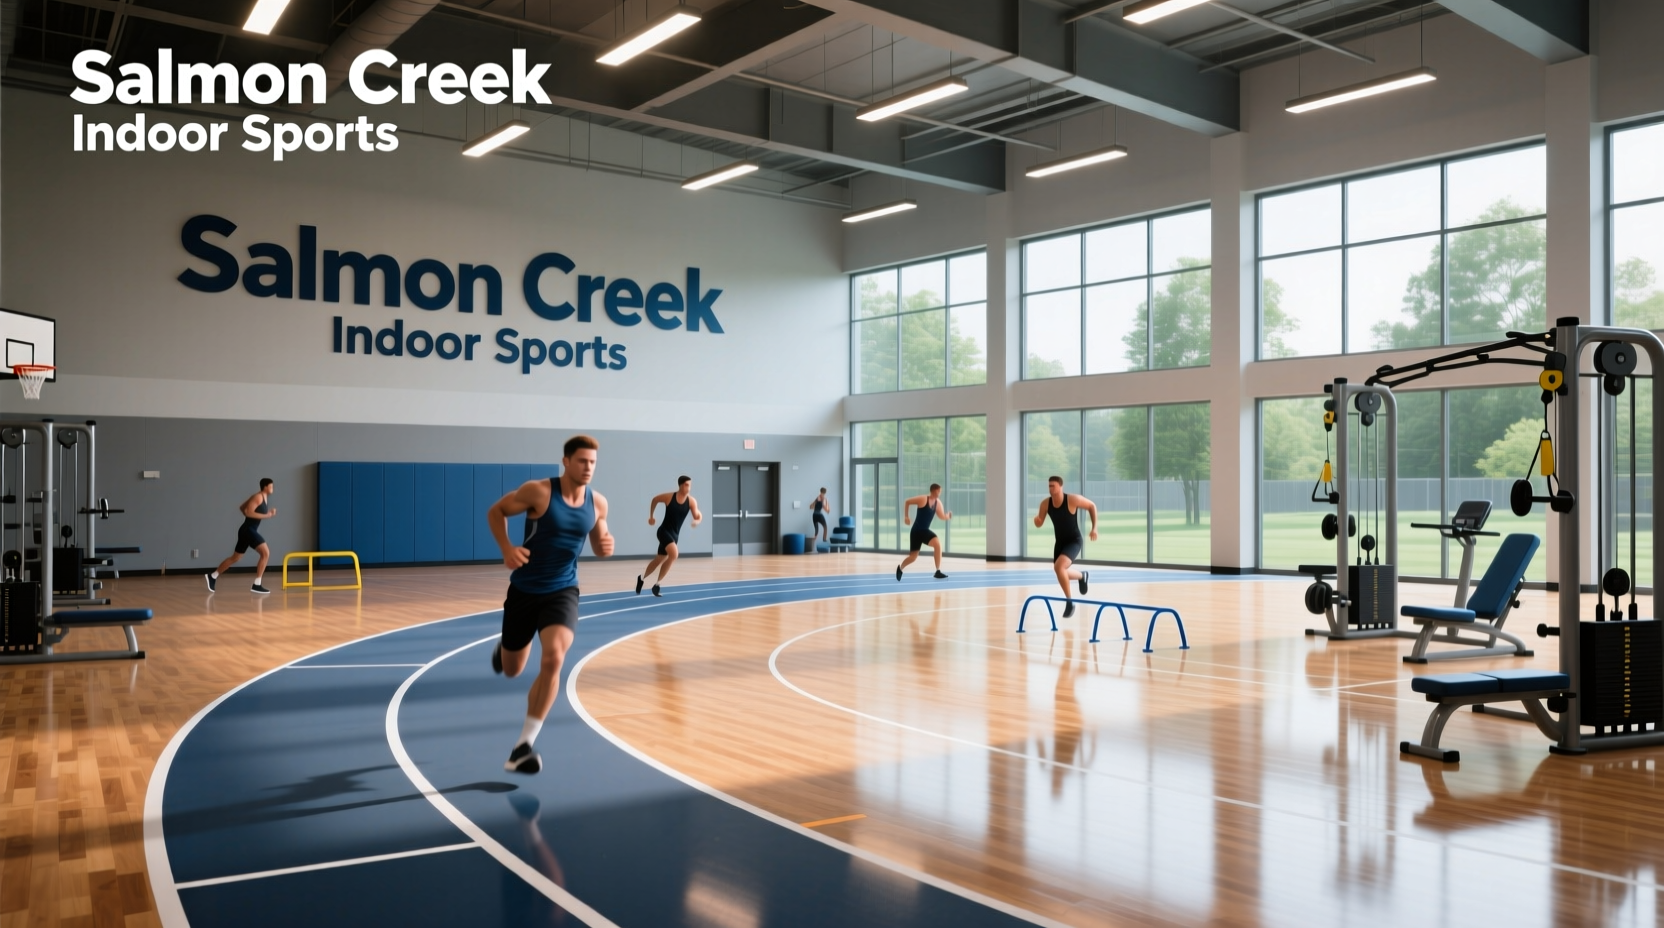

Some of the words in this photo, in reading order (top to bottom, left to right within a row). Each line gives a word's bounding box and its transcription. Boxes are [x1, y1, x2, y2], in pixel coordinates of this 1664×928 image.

[178, 214, 503, 316] Salmon
[521, 251, 724, 334] Creek
[332, 315, 482, 361] Indoor
[494, 327, 628, 374] Sports
